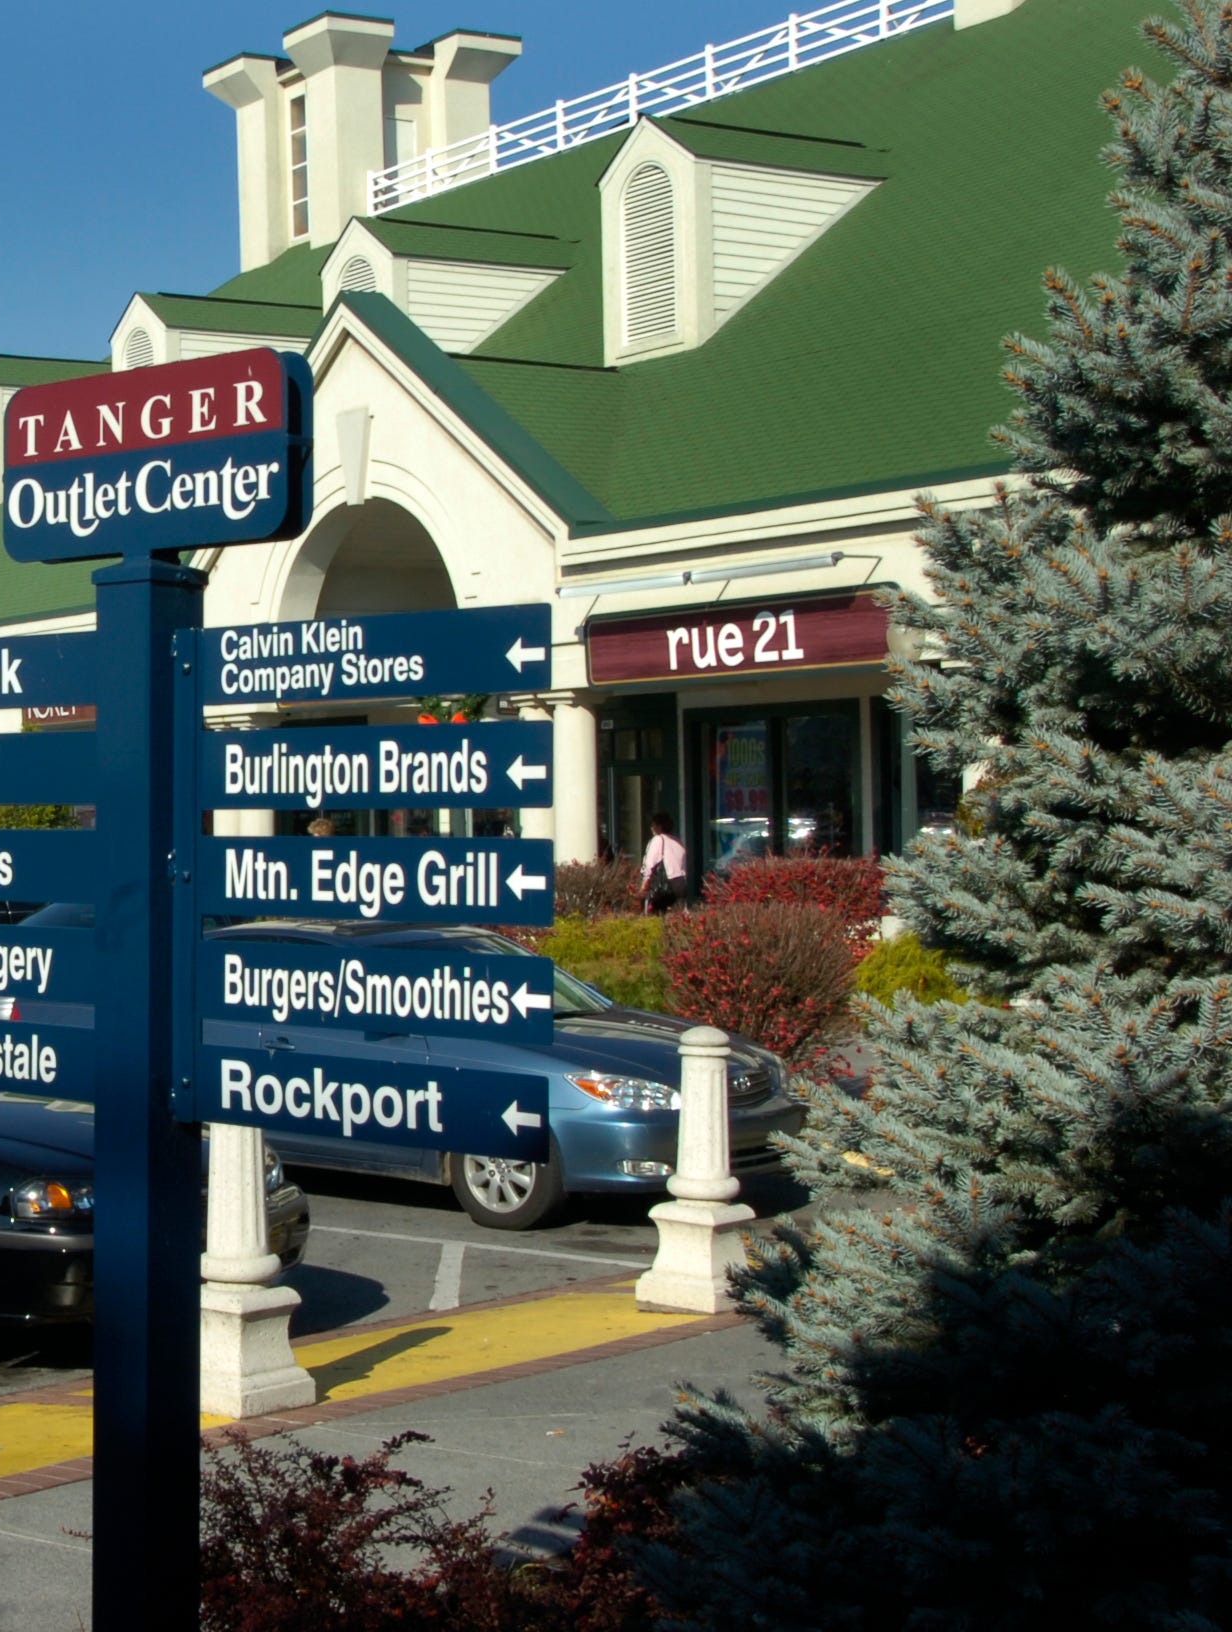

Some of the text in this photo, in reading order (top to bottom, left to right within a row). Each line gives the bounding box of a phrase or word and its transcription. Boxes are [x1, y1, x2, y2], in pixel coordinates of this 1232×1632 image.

[18, 380, 267, 456] TANGER
[220, 618, 363, 661] Calvin Klein
[666, 610, 804, 671] rue 21
[220, 652, 424, 698] Company Stores
[224, 739, 488, 808] Burlington Brands
[225, 849, 498, 918] Mtn. Edge Grill
[224, 953, 510, 1025] Burgers/Smoothies
[220, 1059, 443, 1137] Rockport
